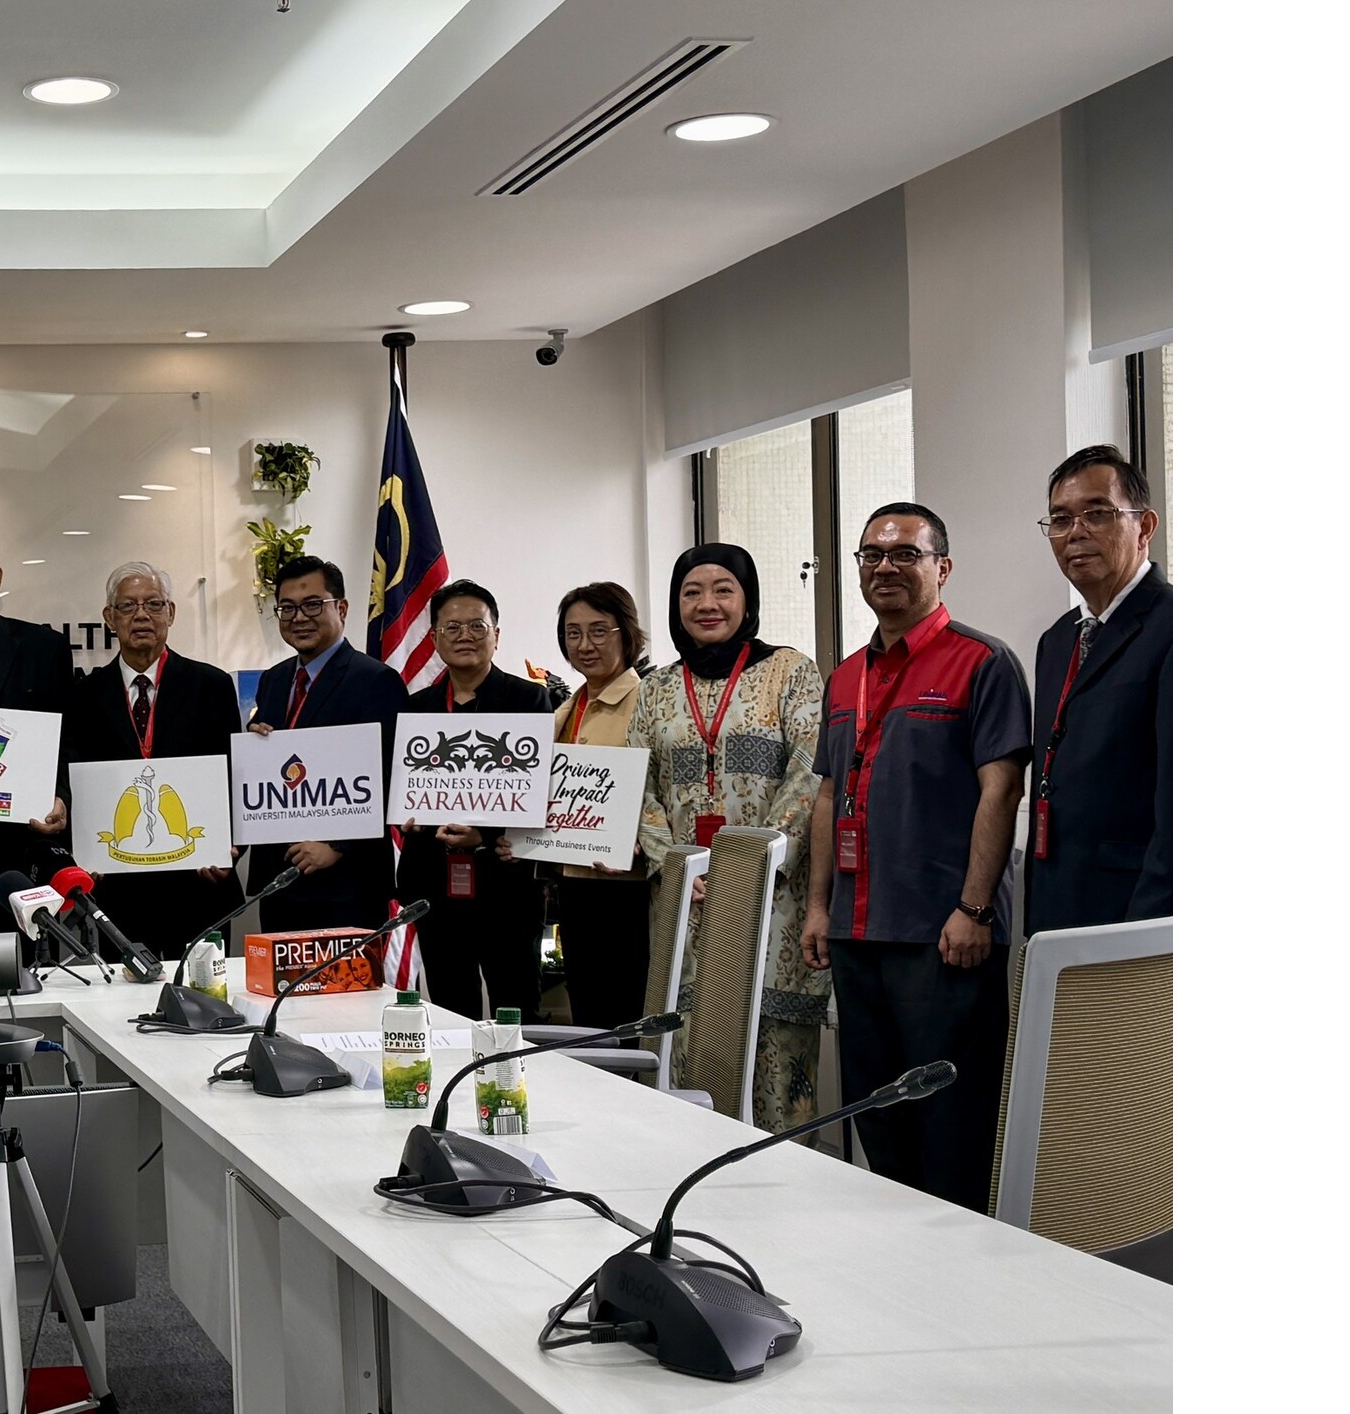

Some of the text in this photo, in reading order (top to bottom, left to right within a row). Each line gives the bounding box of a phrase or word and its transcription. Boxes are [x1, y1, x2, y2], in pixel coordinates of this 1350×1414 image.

[550, 753, 611, 788] Driving
[242, 775, 372, 811] UNIMAS
[407, 777, 532, 790] BUSINESS EVENTS
[404, 790, 528, 812] SARAWAK
[553, 775, 616, 816] Impact
[242, 806, 372, 822] UNIVERSITI MALAYSIA SARAWAK
[167, 847, 191, 860] MALAYSIA
[525, 836, 612, 853] Through Business Events
[274, 938, 366, 966] PREMIER
[384, 1031, 426, 1042] BORNEO
